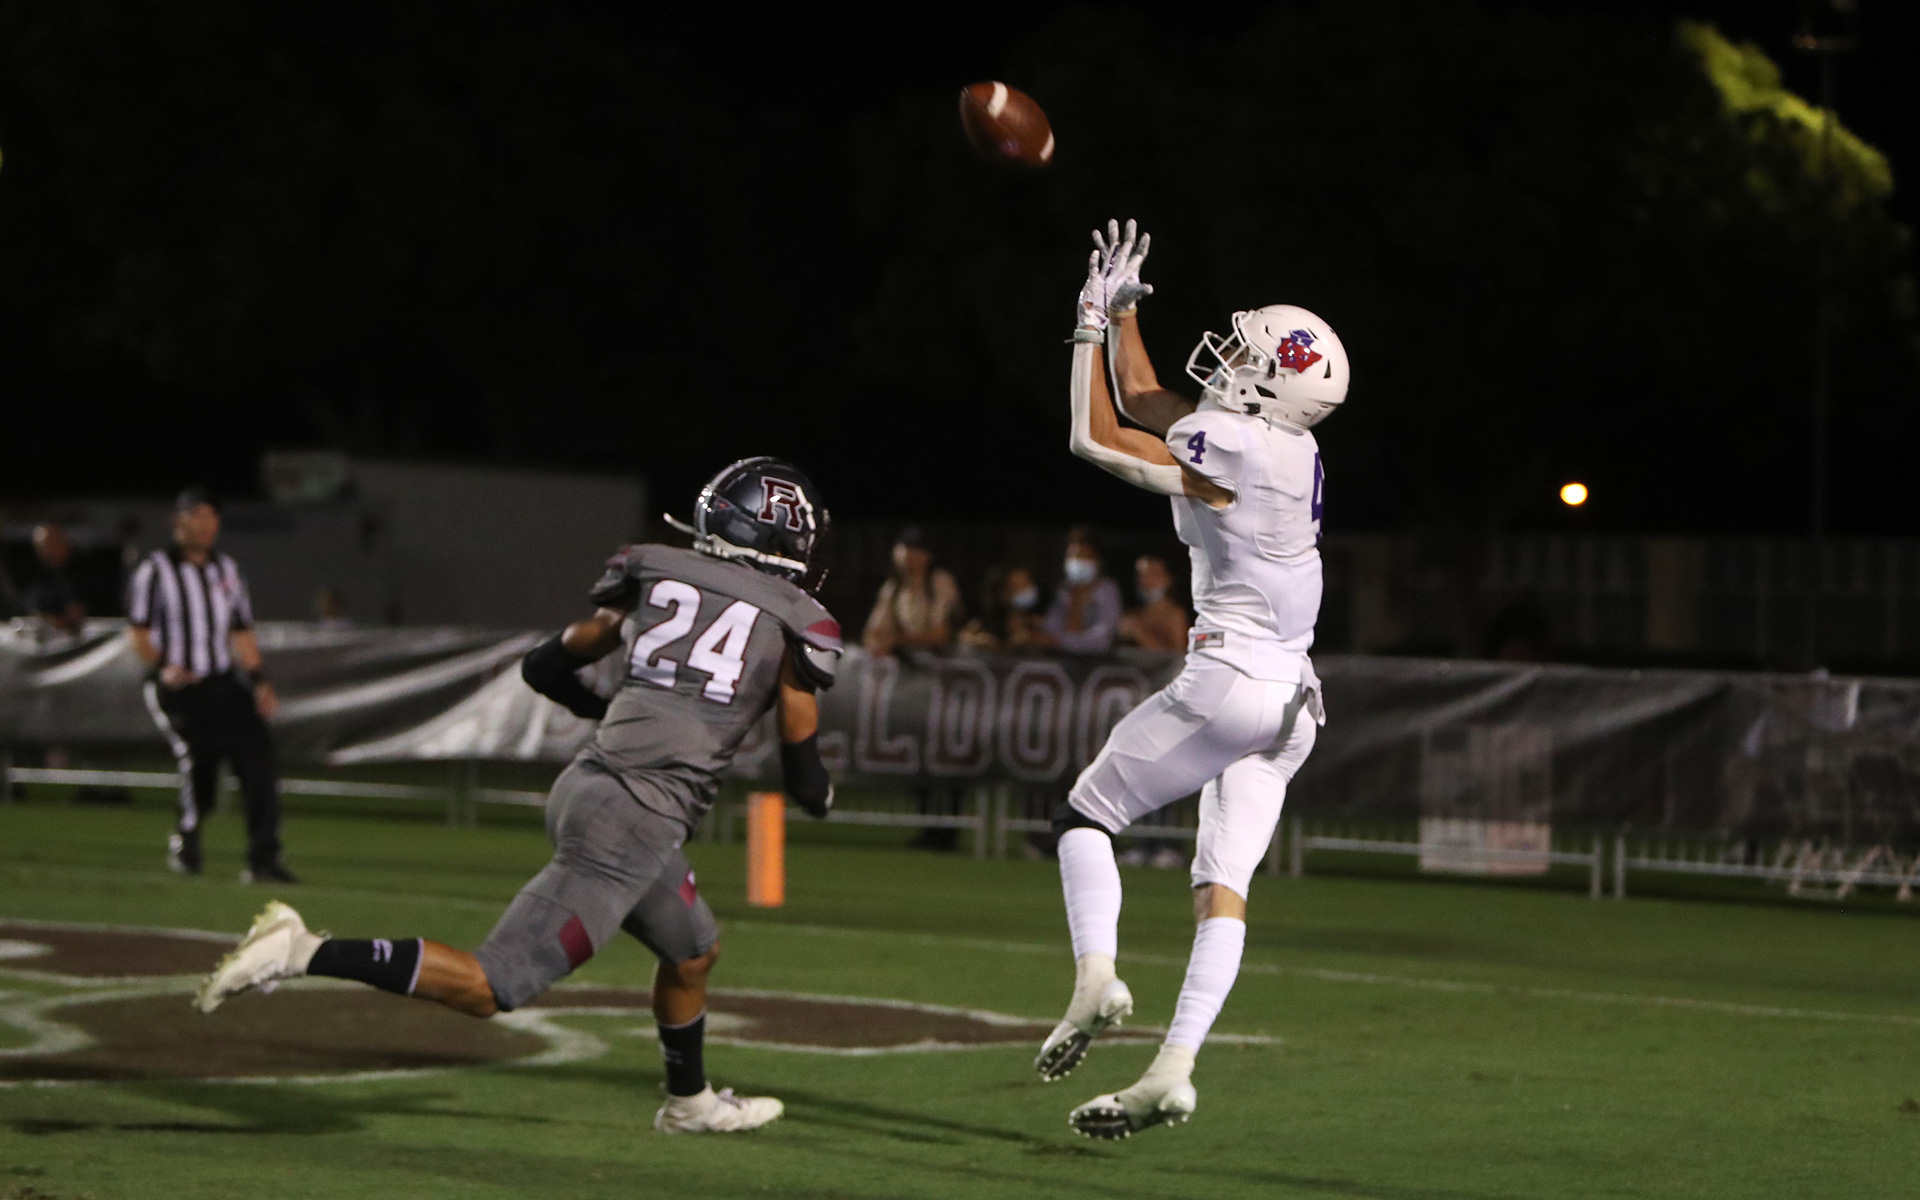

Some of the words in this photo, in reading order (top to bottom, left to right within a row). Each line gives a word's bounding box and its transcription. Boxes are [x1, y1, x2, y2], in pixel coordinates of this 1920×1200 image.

[1187, 431, 1206, 465] 4
[757, 475, 804, 532] R
[630, 579, 763, 705] 24
